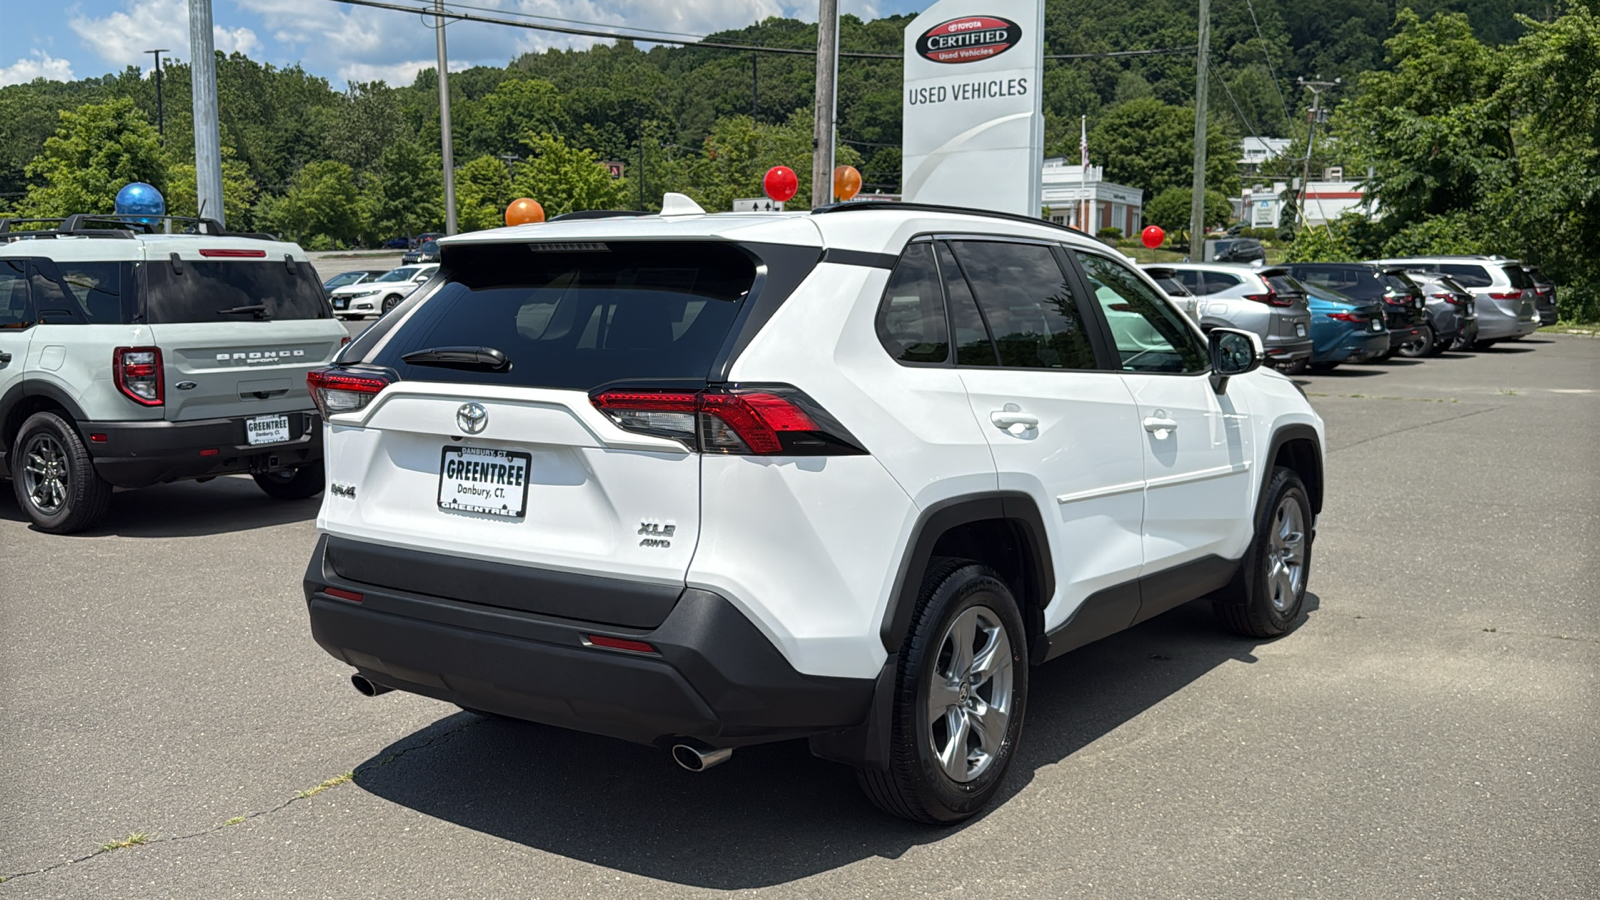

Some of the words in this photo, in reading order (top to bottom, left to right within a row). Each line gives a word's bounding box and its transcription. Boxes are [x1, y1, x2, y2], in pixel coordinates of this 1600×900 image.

[957, 21, 982, 30] TOYOTA
[927, 30, 1008, 50] CERTIFIED
[939, 51, 959, 60] Used
[959, 48, 994, 58] Vehicles
[909, 86, 947, 106] USED
[952, 78, 1027, 101] VEHICLES
[216, 350, 304, 361] BRONCO
[248, 419, 288, 432] GREENTREE
[461, 447, 496, 458] DANBURY,
[446, 459, 524, 487] GREENTREE
[457, 484, 492, 500] Danbury,
[494, 487, 505, 498] CT.
[441, 502, 517, 517] GREENTREE
[637, 522, 676, 538] XLE
[639, 538, 671, 548] AWD
